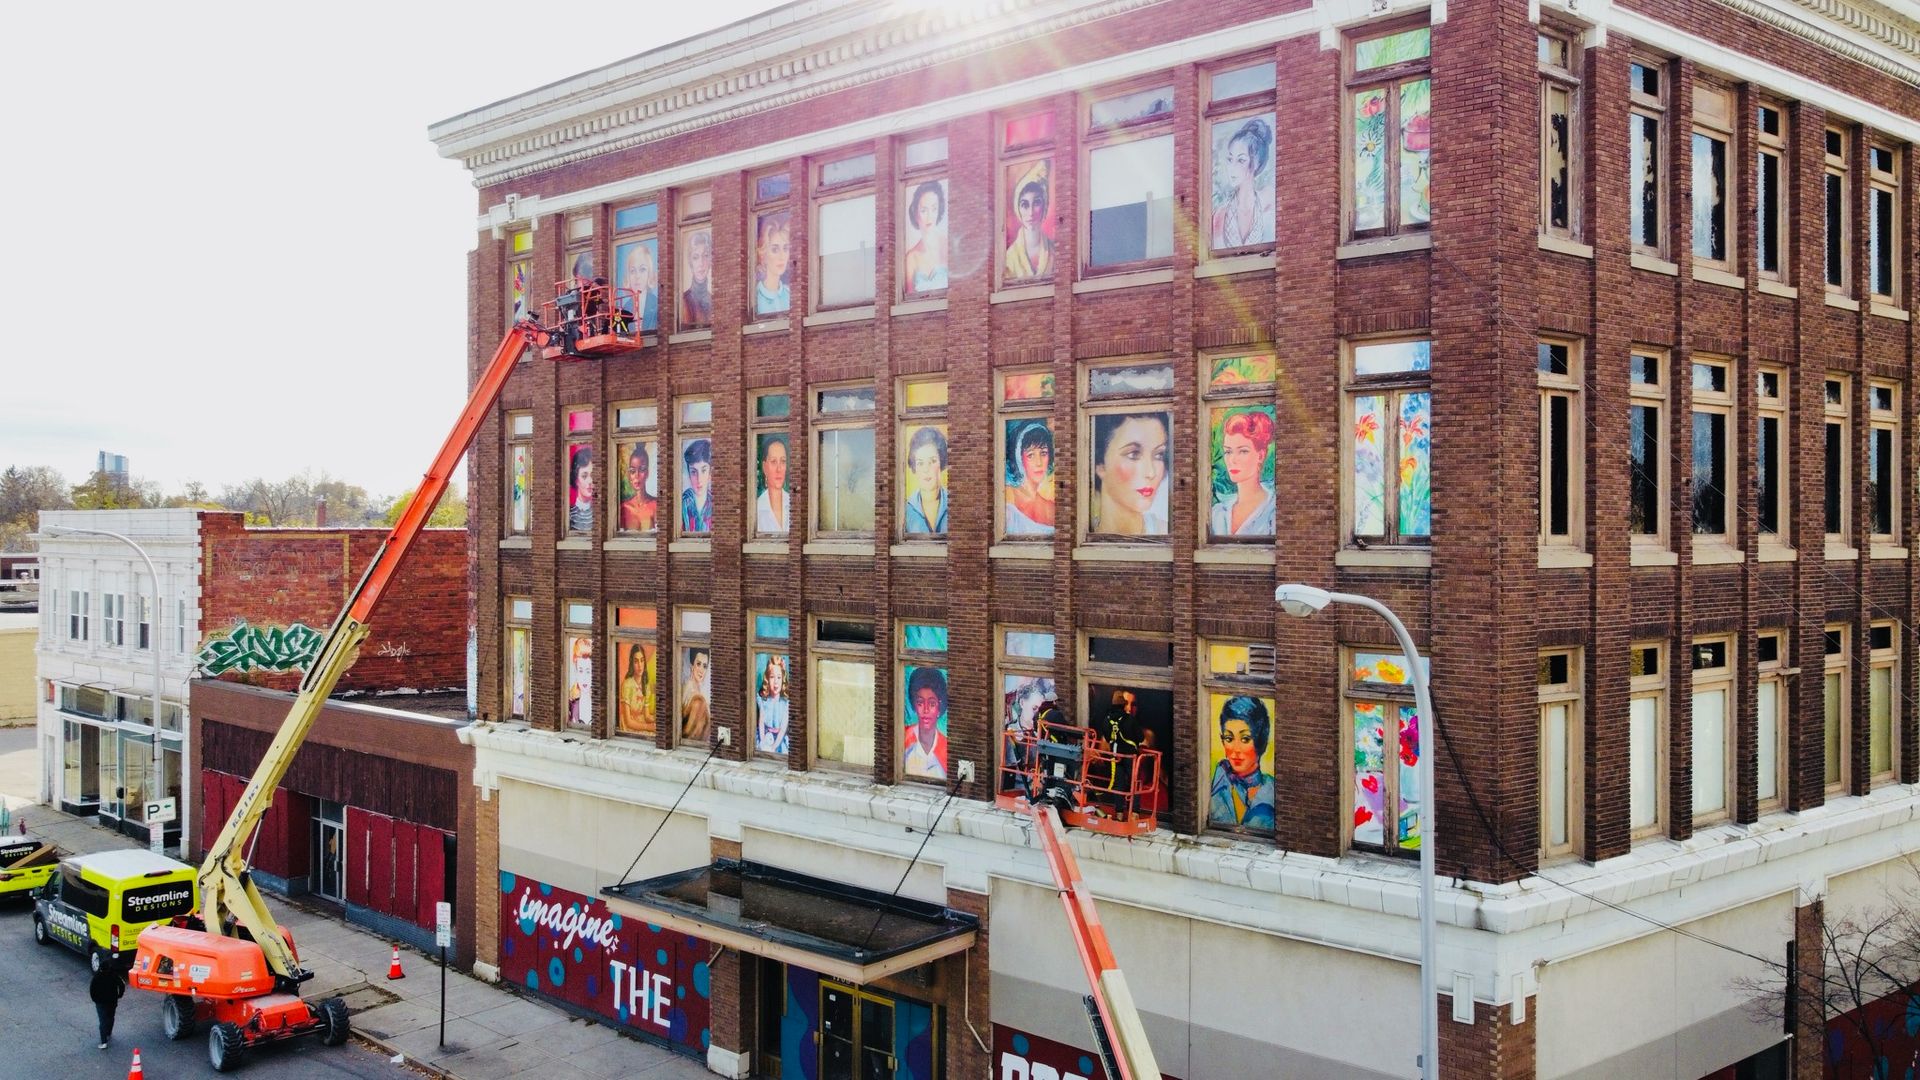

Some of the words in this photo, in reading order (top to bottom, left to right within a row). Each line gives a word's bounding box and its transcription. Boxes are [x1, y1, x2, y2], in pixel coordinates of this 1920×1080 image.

[147, 804, 160, 820] P
[128, 890, 189, 907] Streamline
[135, 899, 182, 912] DESIGNS
[48, 903, 88, 937] Streamline
[519, 886, 614, 950] imagine
[51, 923, 82, 947] DESIGNS
[609, 959, 671, 1028] THE
